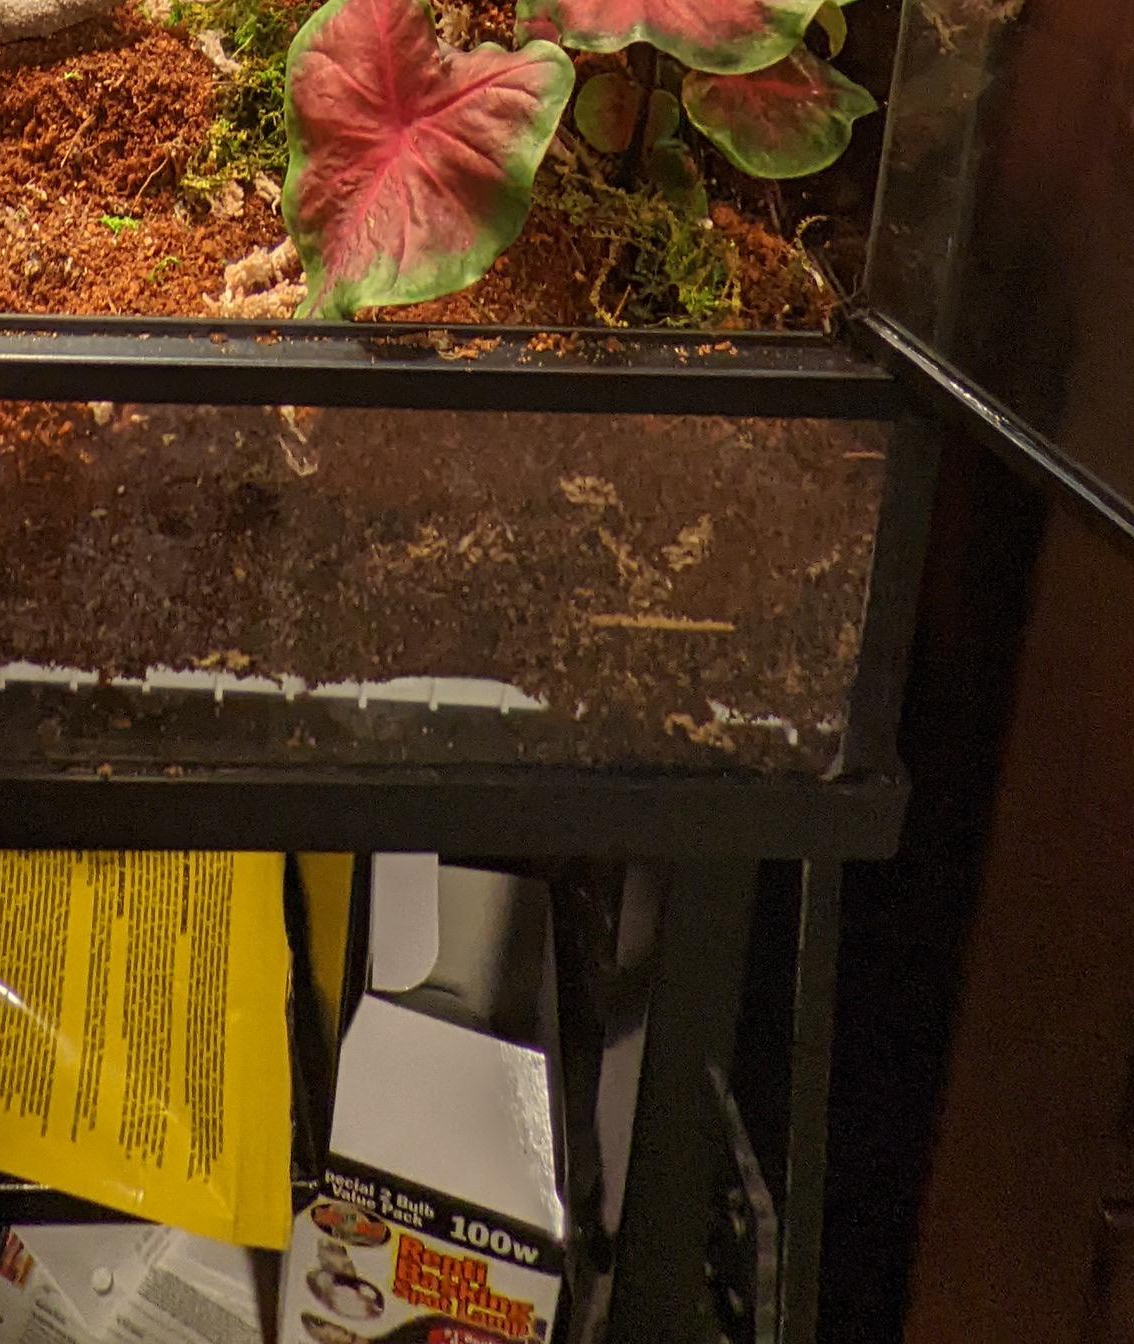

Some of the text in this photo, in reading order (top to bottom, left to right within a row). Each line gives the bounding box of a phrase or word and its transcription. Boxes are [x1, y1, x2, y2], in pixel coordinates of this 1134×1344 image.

[325, 1169, 375, 1198] pecial
[396, 1192, 434, 1219] Bulb
[331, 1181, 423, 1228] Value Pack
